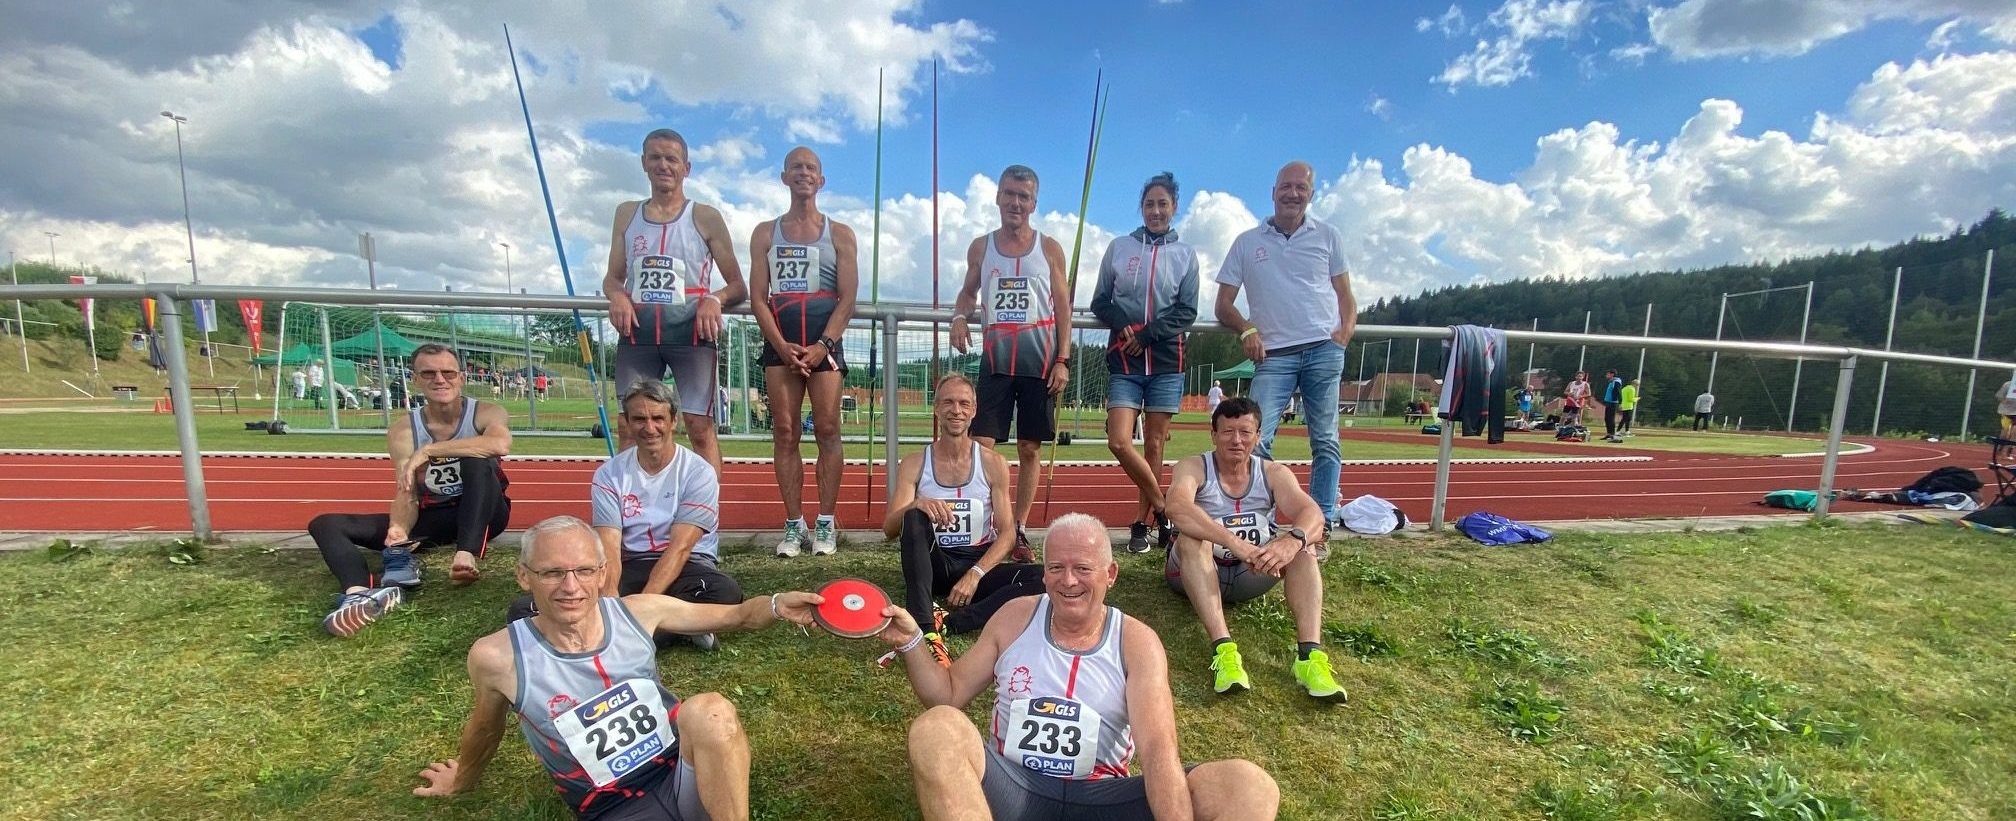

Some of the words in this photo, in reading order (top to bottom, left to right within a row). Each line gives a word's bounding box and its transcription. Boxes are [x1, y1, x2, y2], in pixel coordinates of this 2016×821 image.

[792, 249, 806, 257] GLS
[657, 258, 670, 267] GLS
[775, 261, 810, 279] 237
[639, 272, 676, 290] 232
[994, 293, 1030, 310] 235
[430, 466, 459, 485] 23
[607, 690, 631, 710] GLS
[1054, 704, 1076, 717] GLS
[585, 704, 658, 761] 238
[1018, 720, 1081, 756] 233
[630, 738, 660, 760] PLAN
[1043, 760, 1072, 770] PLAN
